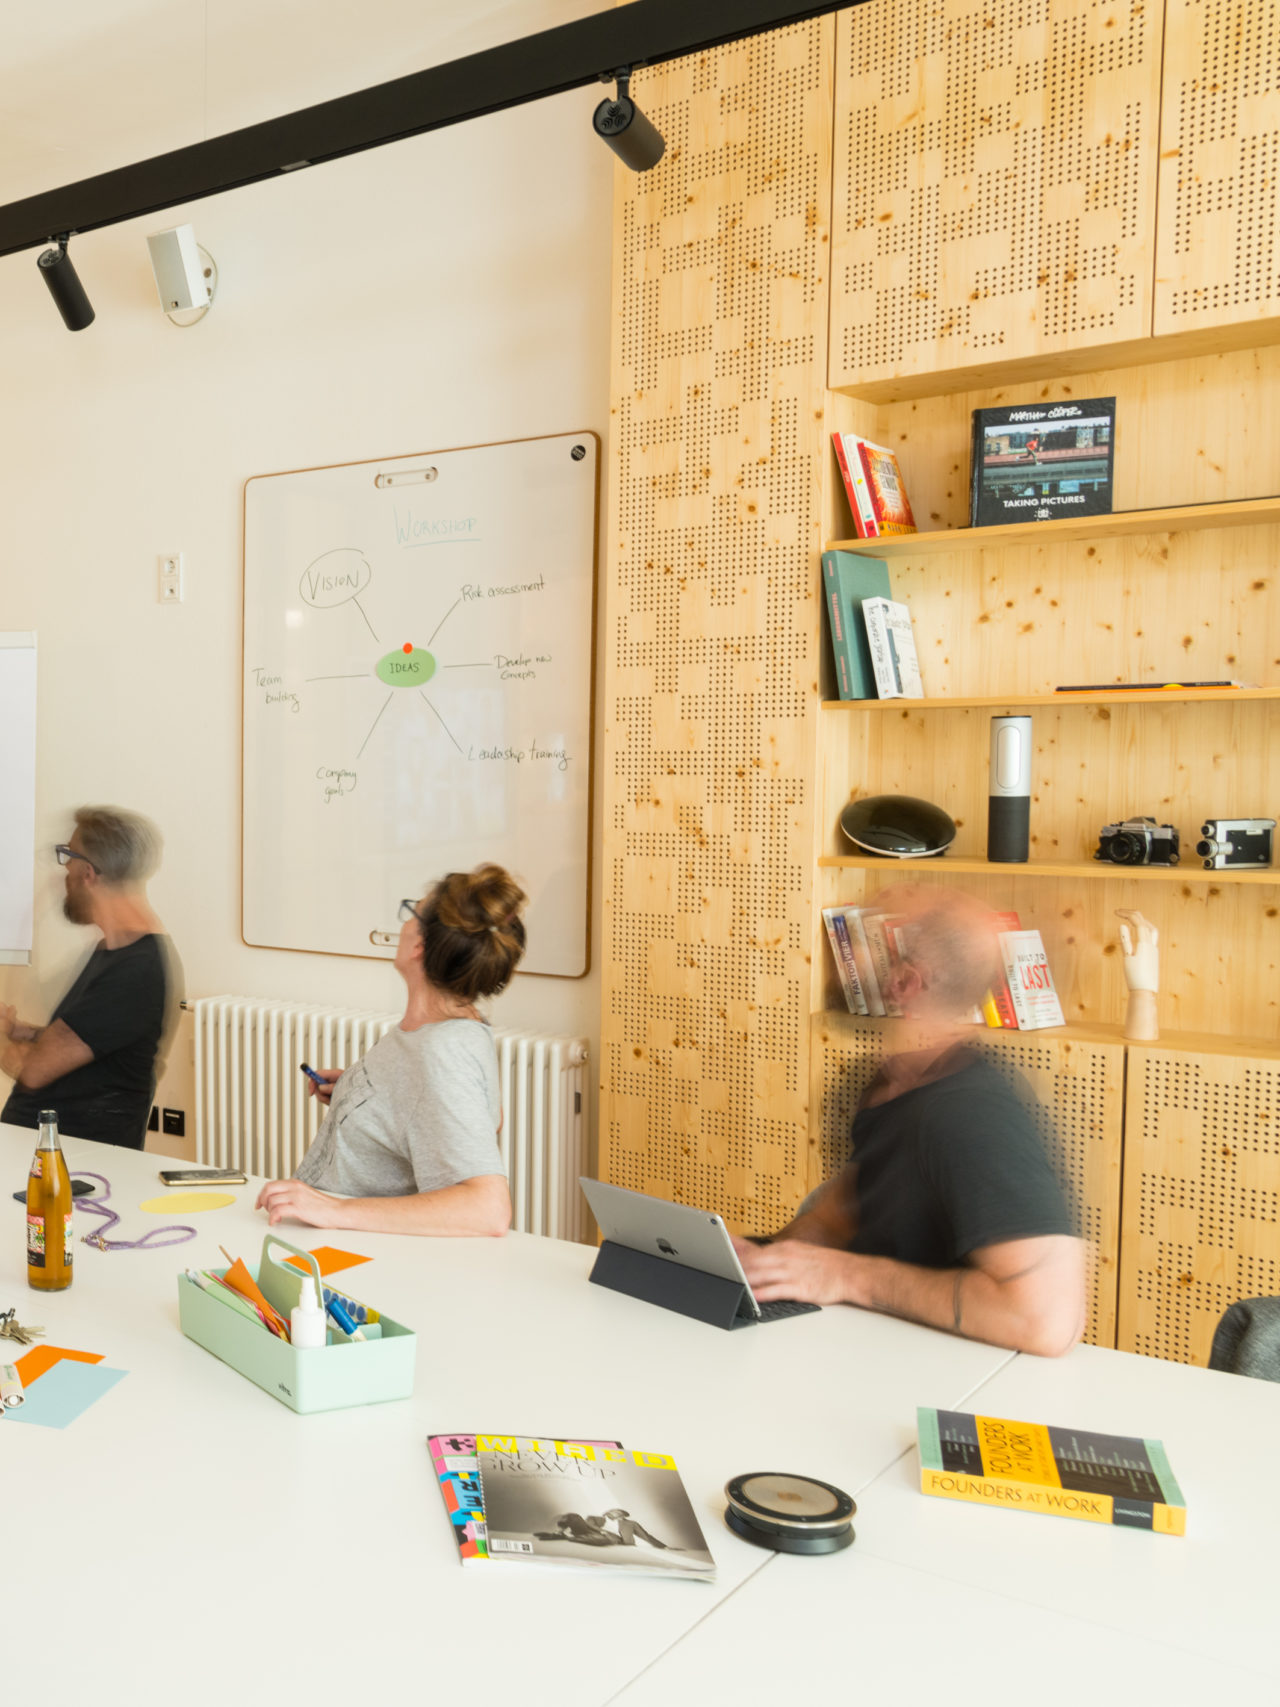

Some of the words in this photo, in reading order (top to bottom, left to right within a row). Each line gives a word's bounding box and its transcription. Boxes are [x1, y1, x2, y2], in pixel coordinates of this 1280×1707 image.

[1003, 498, 1039, 508] TAKING
[1041, 495, 1086, 506] PICTURES
[307, 569, 359, 601] VISION
[487, 573, 545, 598] assessment
[252, 667, 282, 687] Team
[389, 662, 420, 674] IDEAS
[265, 690, 300, 713] building
[1019, 964, 1051, 990] LAST
[480, 1436, 669, 1468] WIRED
[931, 1475, 1022, 1502] FOUNDERS
[1026, 1493, 1043, 1503] AT
[1046, 1494, 1102, 1516] WORK
